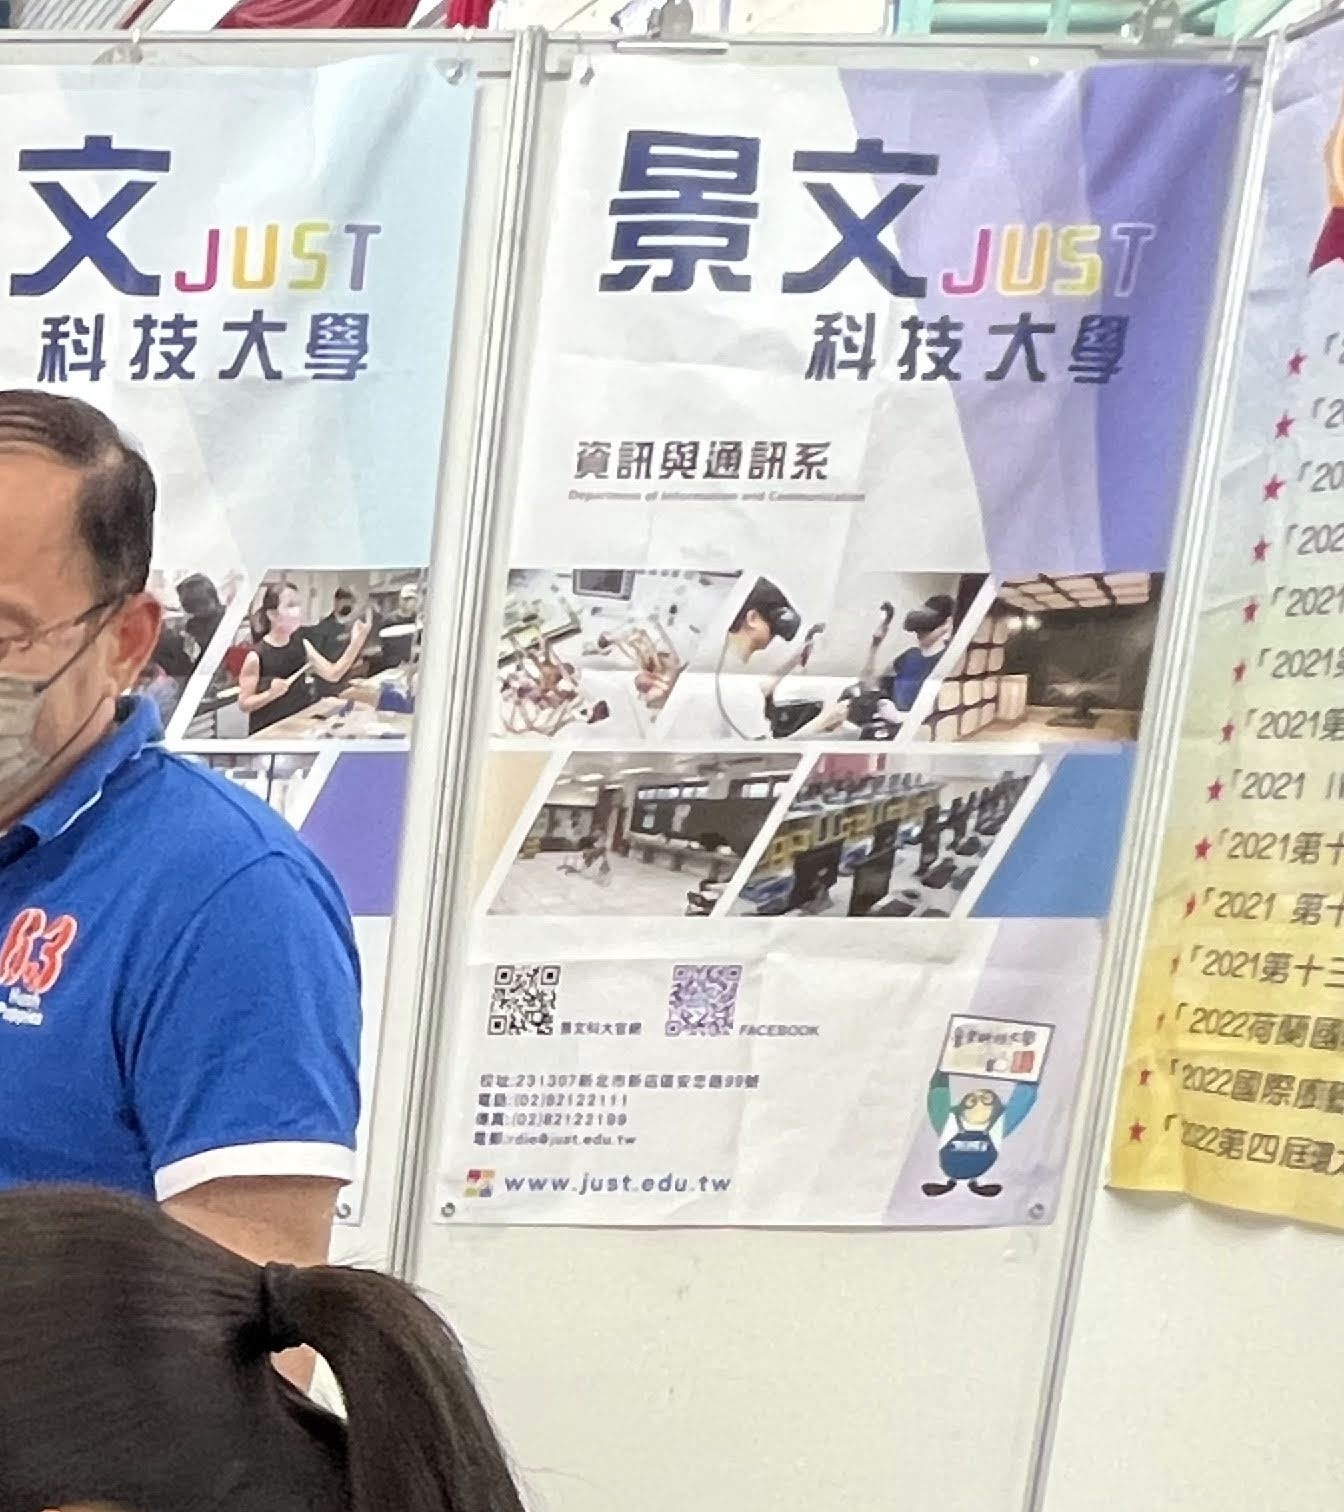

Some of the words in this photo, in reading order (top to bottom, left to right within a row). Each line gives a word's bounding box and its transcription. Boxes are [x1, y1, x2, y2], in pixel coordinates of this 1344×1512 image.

[599, 130, 940, 298] 景文
[174, 222, 381, 292] JUST
[941, 224, 1155, 295] JUST
[38, 309, 370, 383] 科技大學
[805, 312, 1130, 384] 科技大學
[574, 440, 832, 480] 資訊與通訊系
[504, 1171, 732, 1196] www.just.edu.tw
